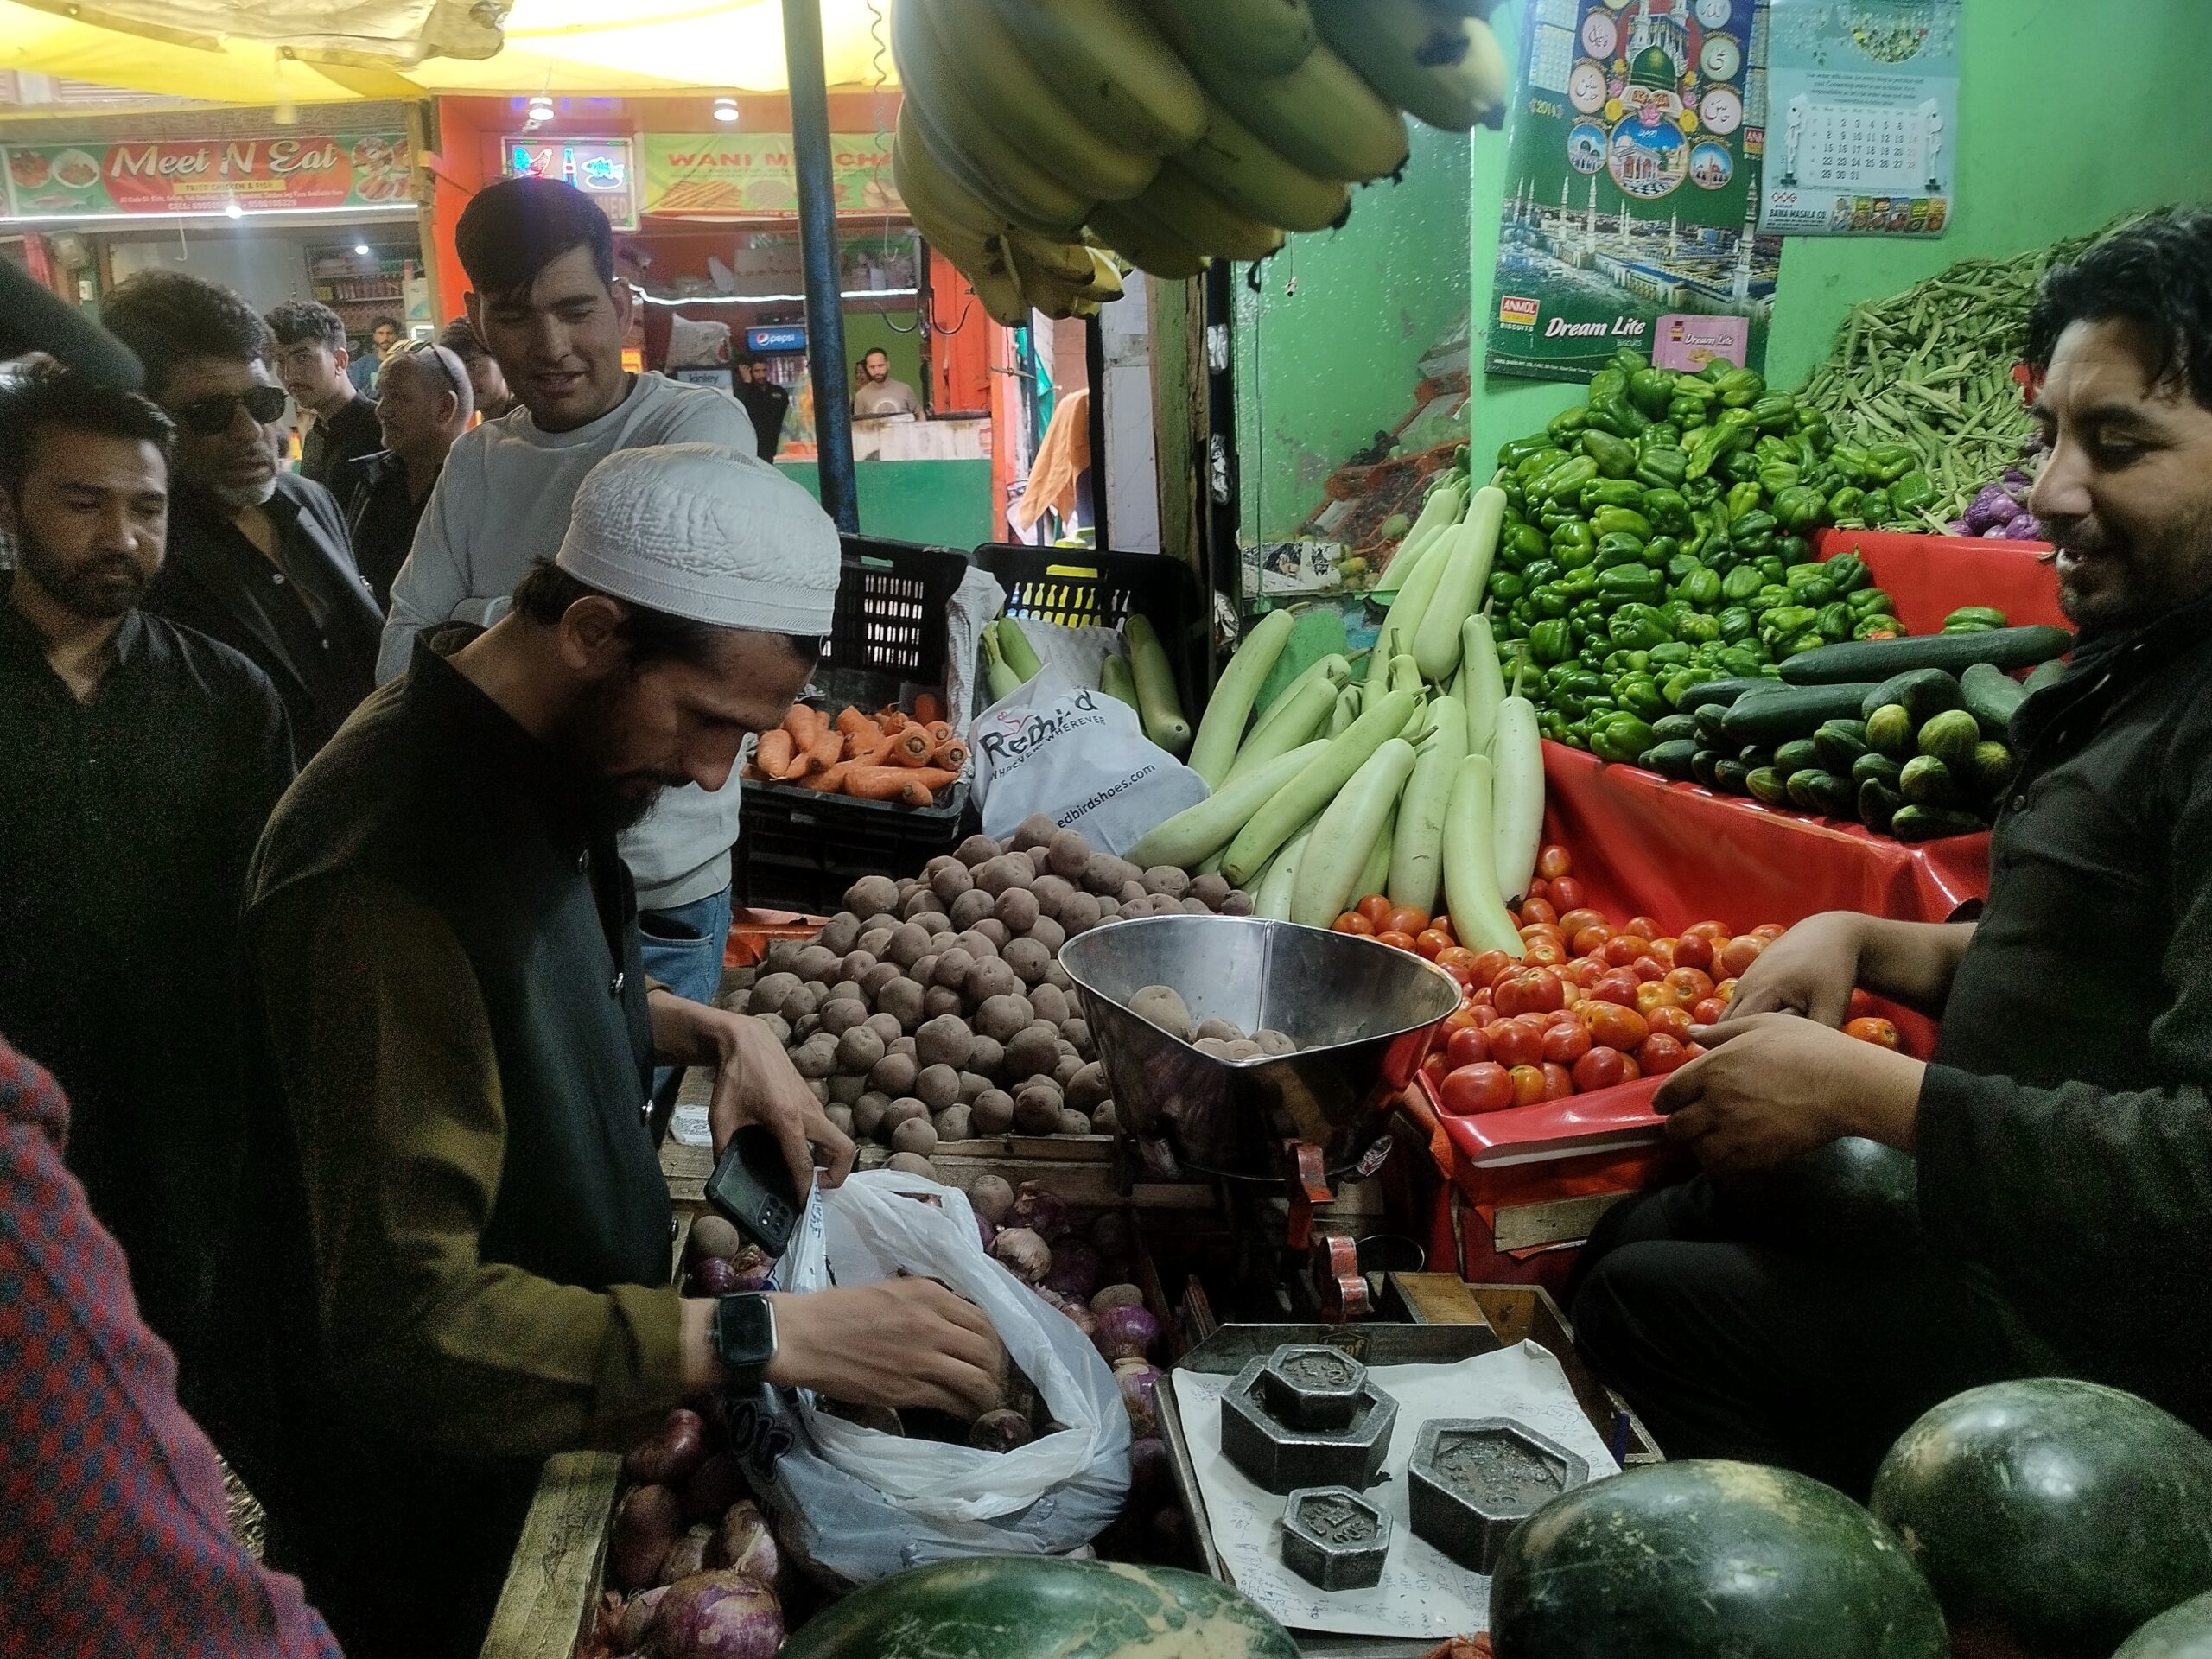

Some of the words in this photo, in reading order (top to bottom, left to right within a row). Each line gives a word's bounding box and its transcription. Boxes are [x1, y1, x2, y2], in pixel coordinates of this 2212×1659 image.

[111, 145, 211, 177] Meet
[219, 143, 257, 174] N
[269, 140, 338, 172] Eat
[668, 153, 751, 166] WANI
[1503, 300, 1535, 314] ANMOL
[1500, 322, 1534, 333] BISCUITS
[1545, 317, 1608, 337] Dream
[1611, 315, 1646, 335] Lite
[770, 334, 794, 344] pepsi
[1684, 334, 1715, 346] Dream
[1717, 334, 1733, 346] Lite
[1046, 715, 1106, 741] WHEREVER
